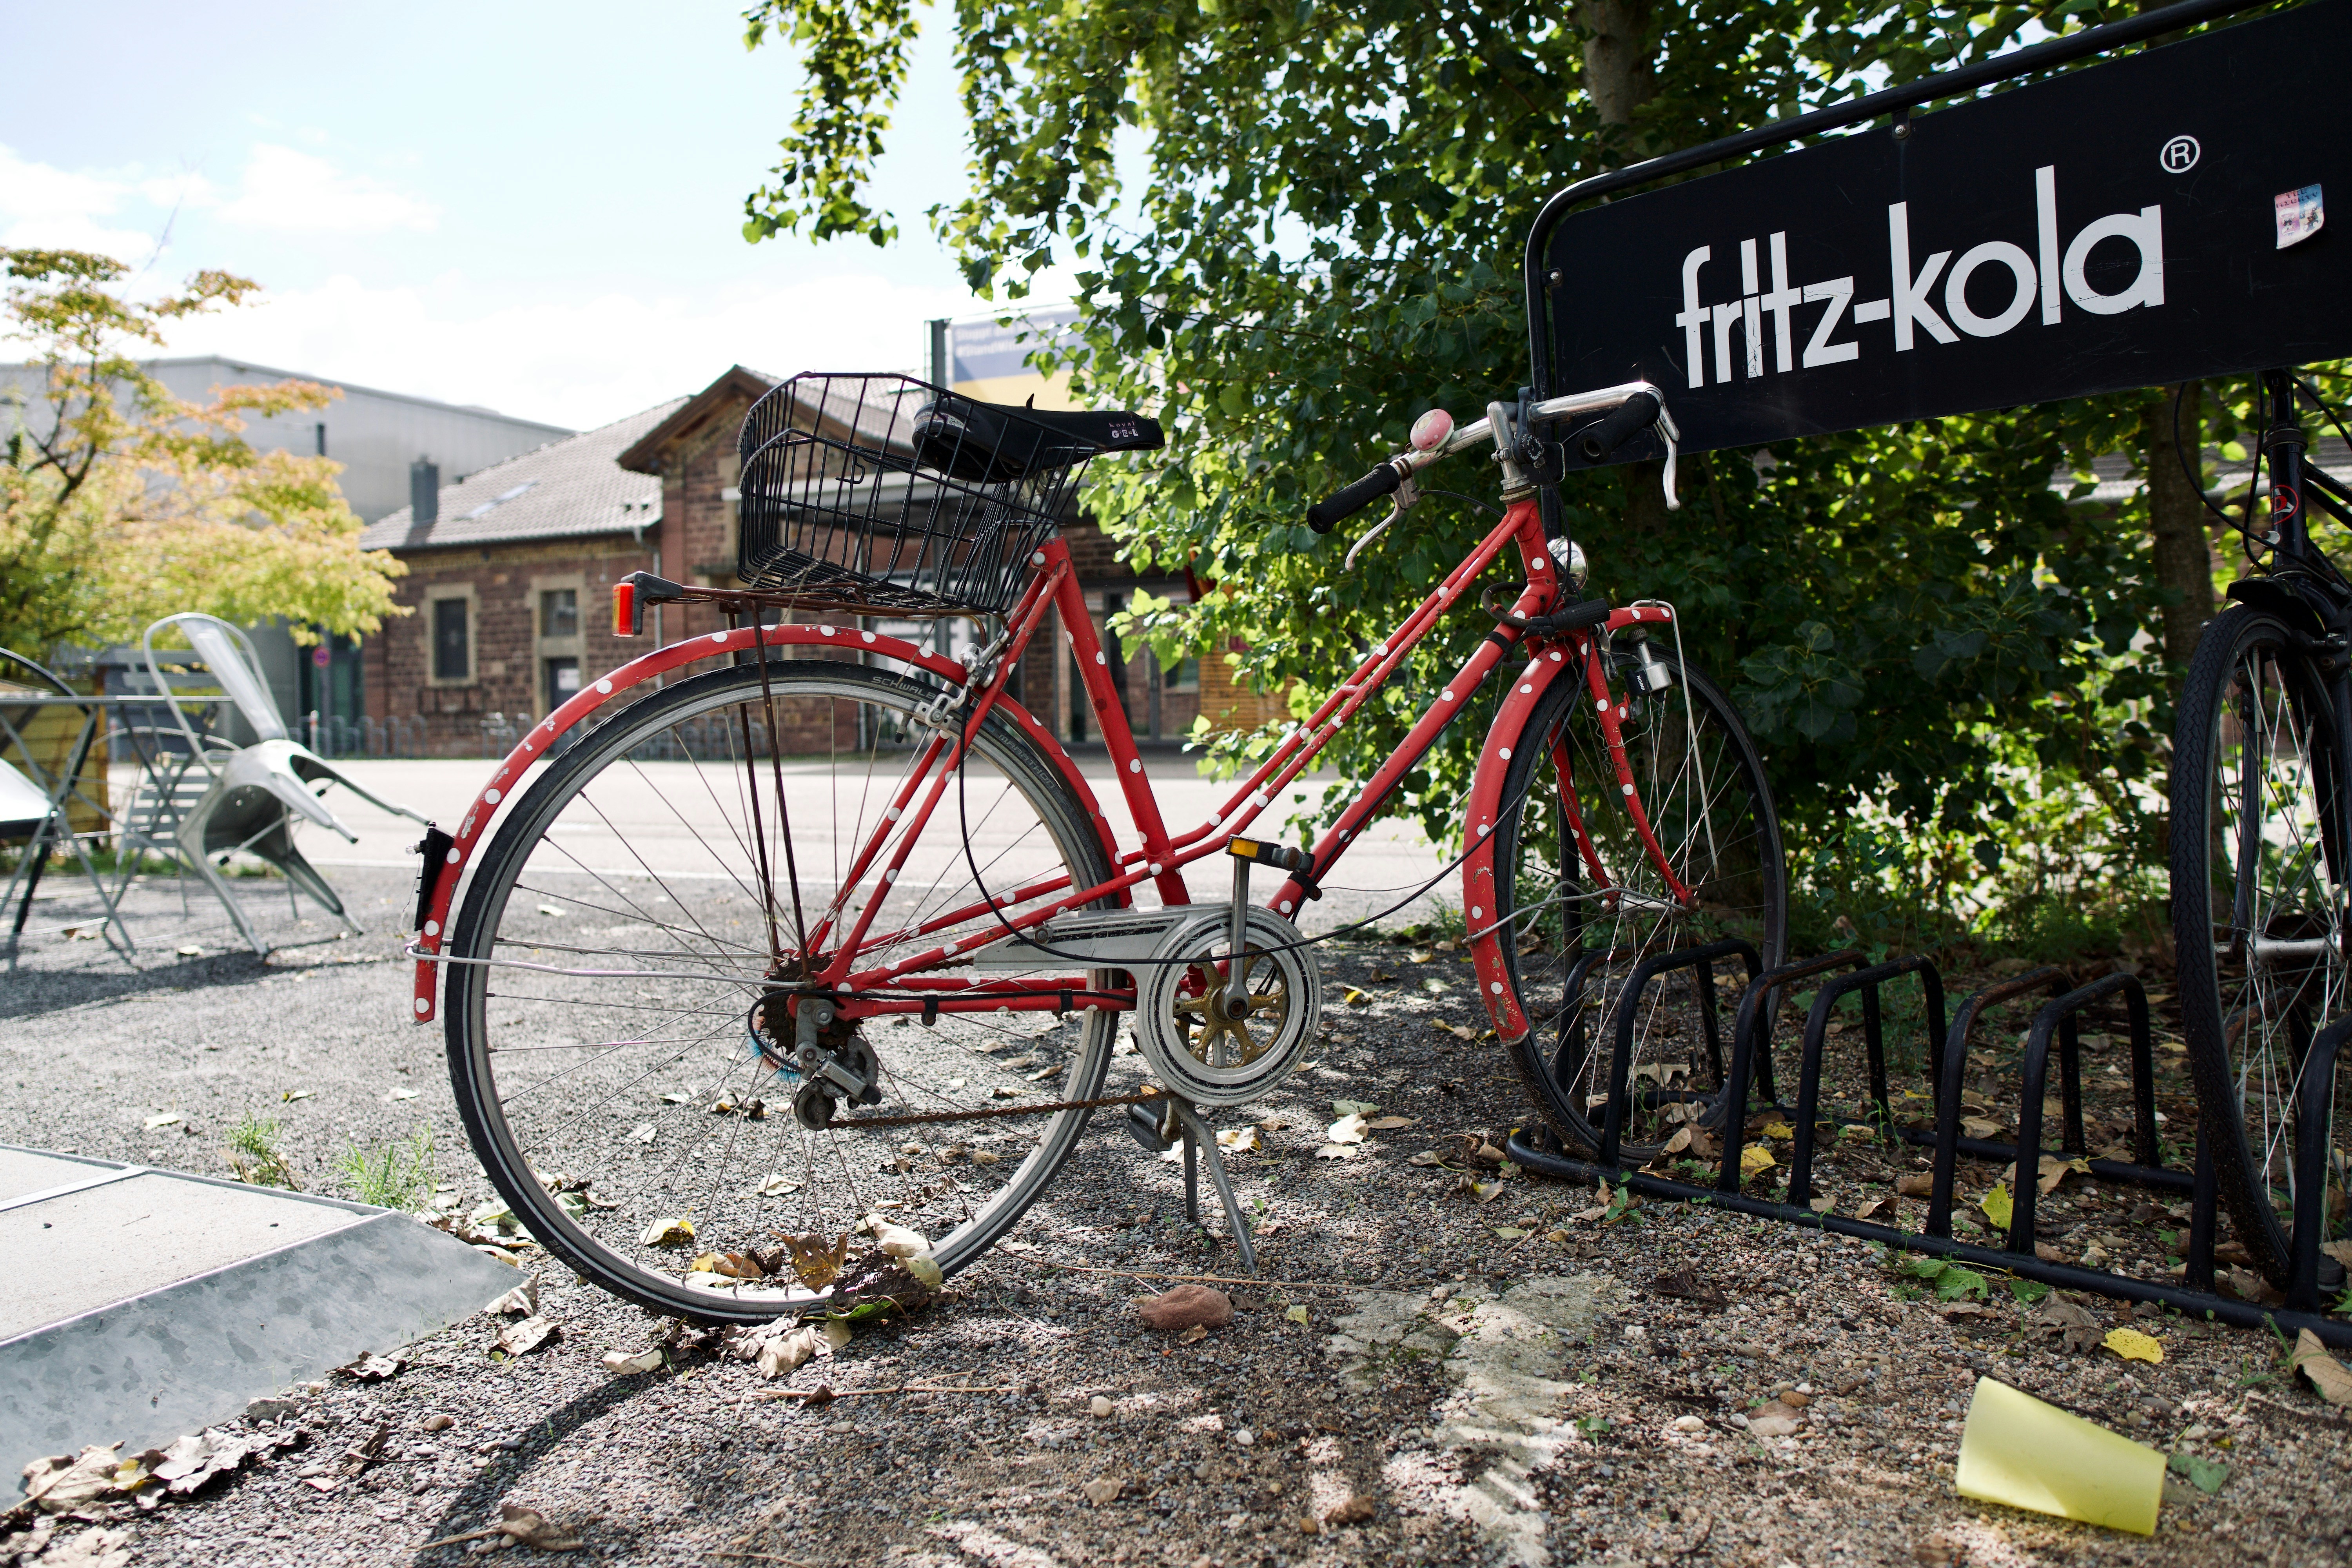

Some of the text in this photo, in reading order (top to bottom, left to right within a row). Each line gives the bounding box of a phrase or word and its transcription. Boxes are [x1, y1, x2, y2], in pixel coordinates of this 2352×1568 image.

[1676, 165, 2165, 389] fritz-kola
[871, 676, 937, 700] SCHWALB
[1637, 675, 1645, 691] UNION
